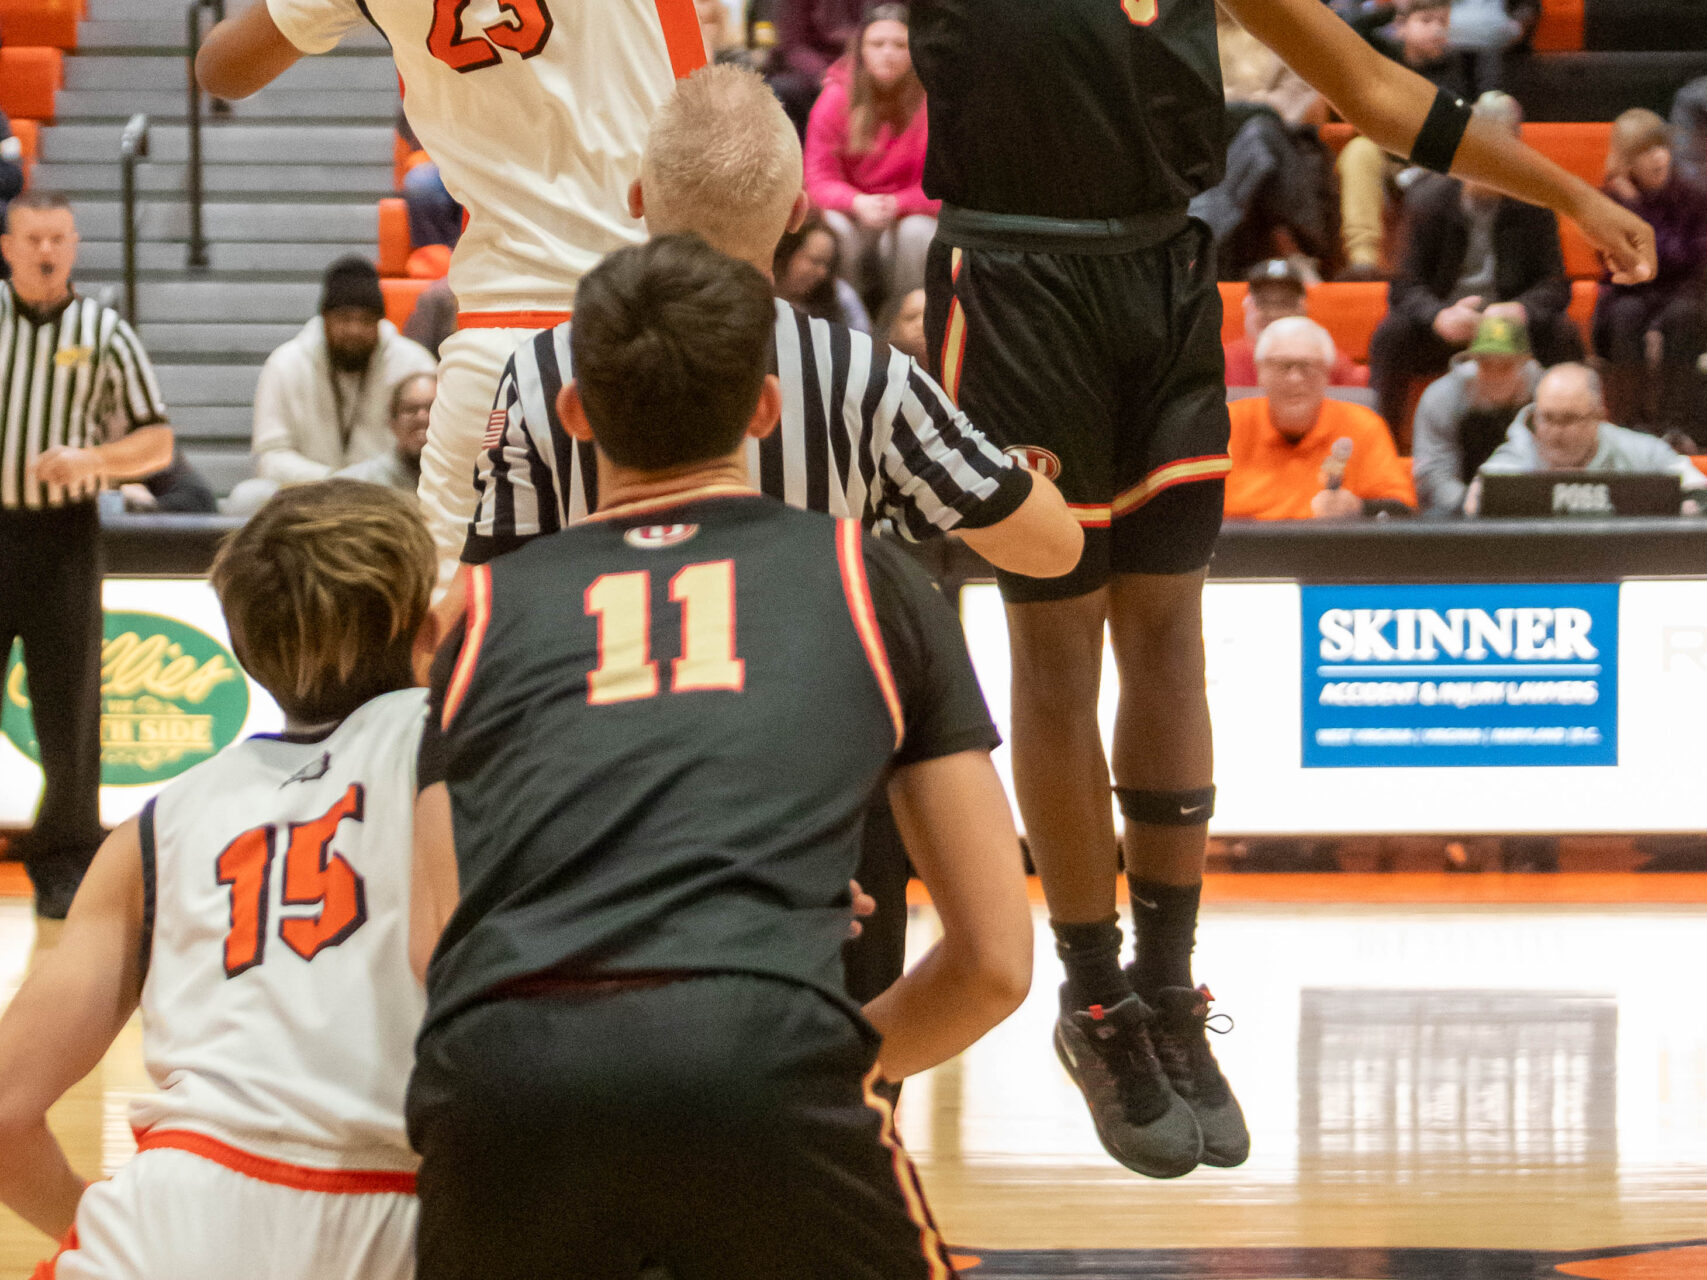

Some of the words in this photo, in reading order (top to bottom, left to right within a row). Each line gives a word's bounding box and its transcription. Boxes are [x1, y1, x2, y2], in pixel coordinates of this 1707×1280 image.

[583, 558, 746, 706] 11
[1318, 607, 1599, 661] SKINNER
[1318, 681, 1419, 707] ACCIDENT
[1505, 680, 1599, 706] LAWYERS
[215, 782, 368, 980] 15
